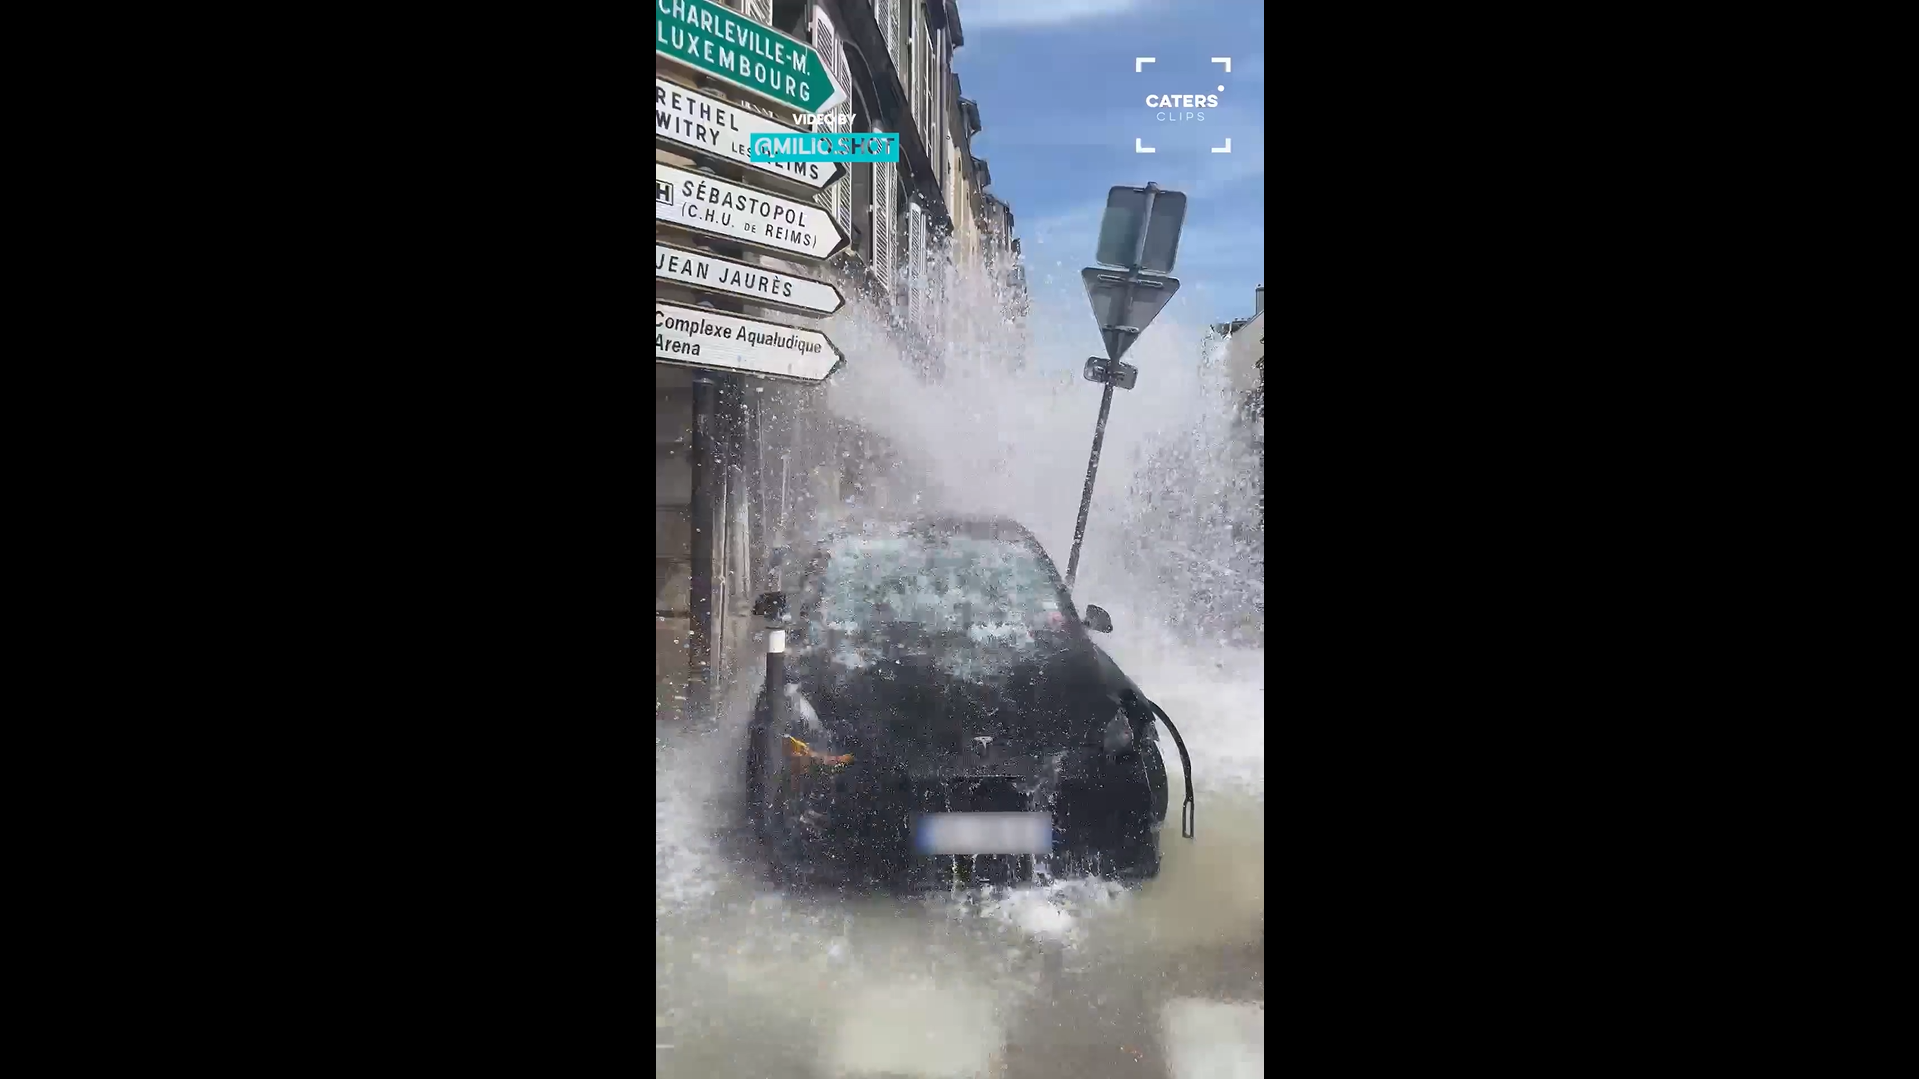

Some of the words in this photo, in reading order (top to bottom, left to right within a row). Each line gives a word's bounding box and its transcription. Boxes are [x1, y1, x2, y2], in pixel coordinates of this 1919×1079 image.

[657, 20, 810, 101] LUXEMBOURG
[658, 0, 811, 76] CHARLEVILLE-M.
[656, 86, 739, 132] RETHEL
[656, 109, 720, 146] WITRY
[681, 202, 735, 228] (C.H.U.
[765, 222, 817, 249] REIMS)
[682, 180, 806, 228] SÉBASTOPOL
[656, 253, 710, 280] JEAN
[719, 267, 793, 298] JAURÈS
[656, 310, 732, 339] Complexe
[736, 325, 822, 356] Aqualudique
[656, 333, 701, 356] Arena
